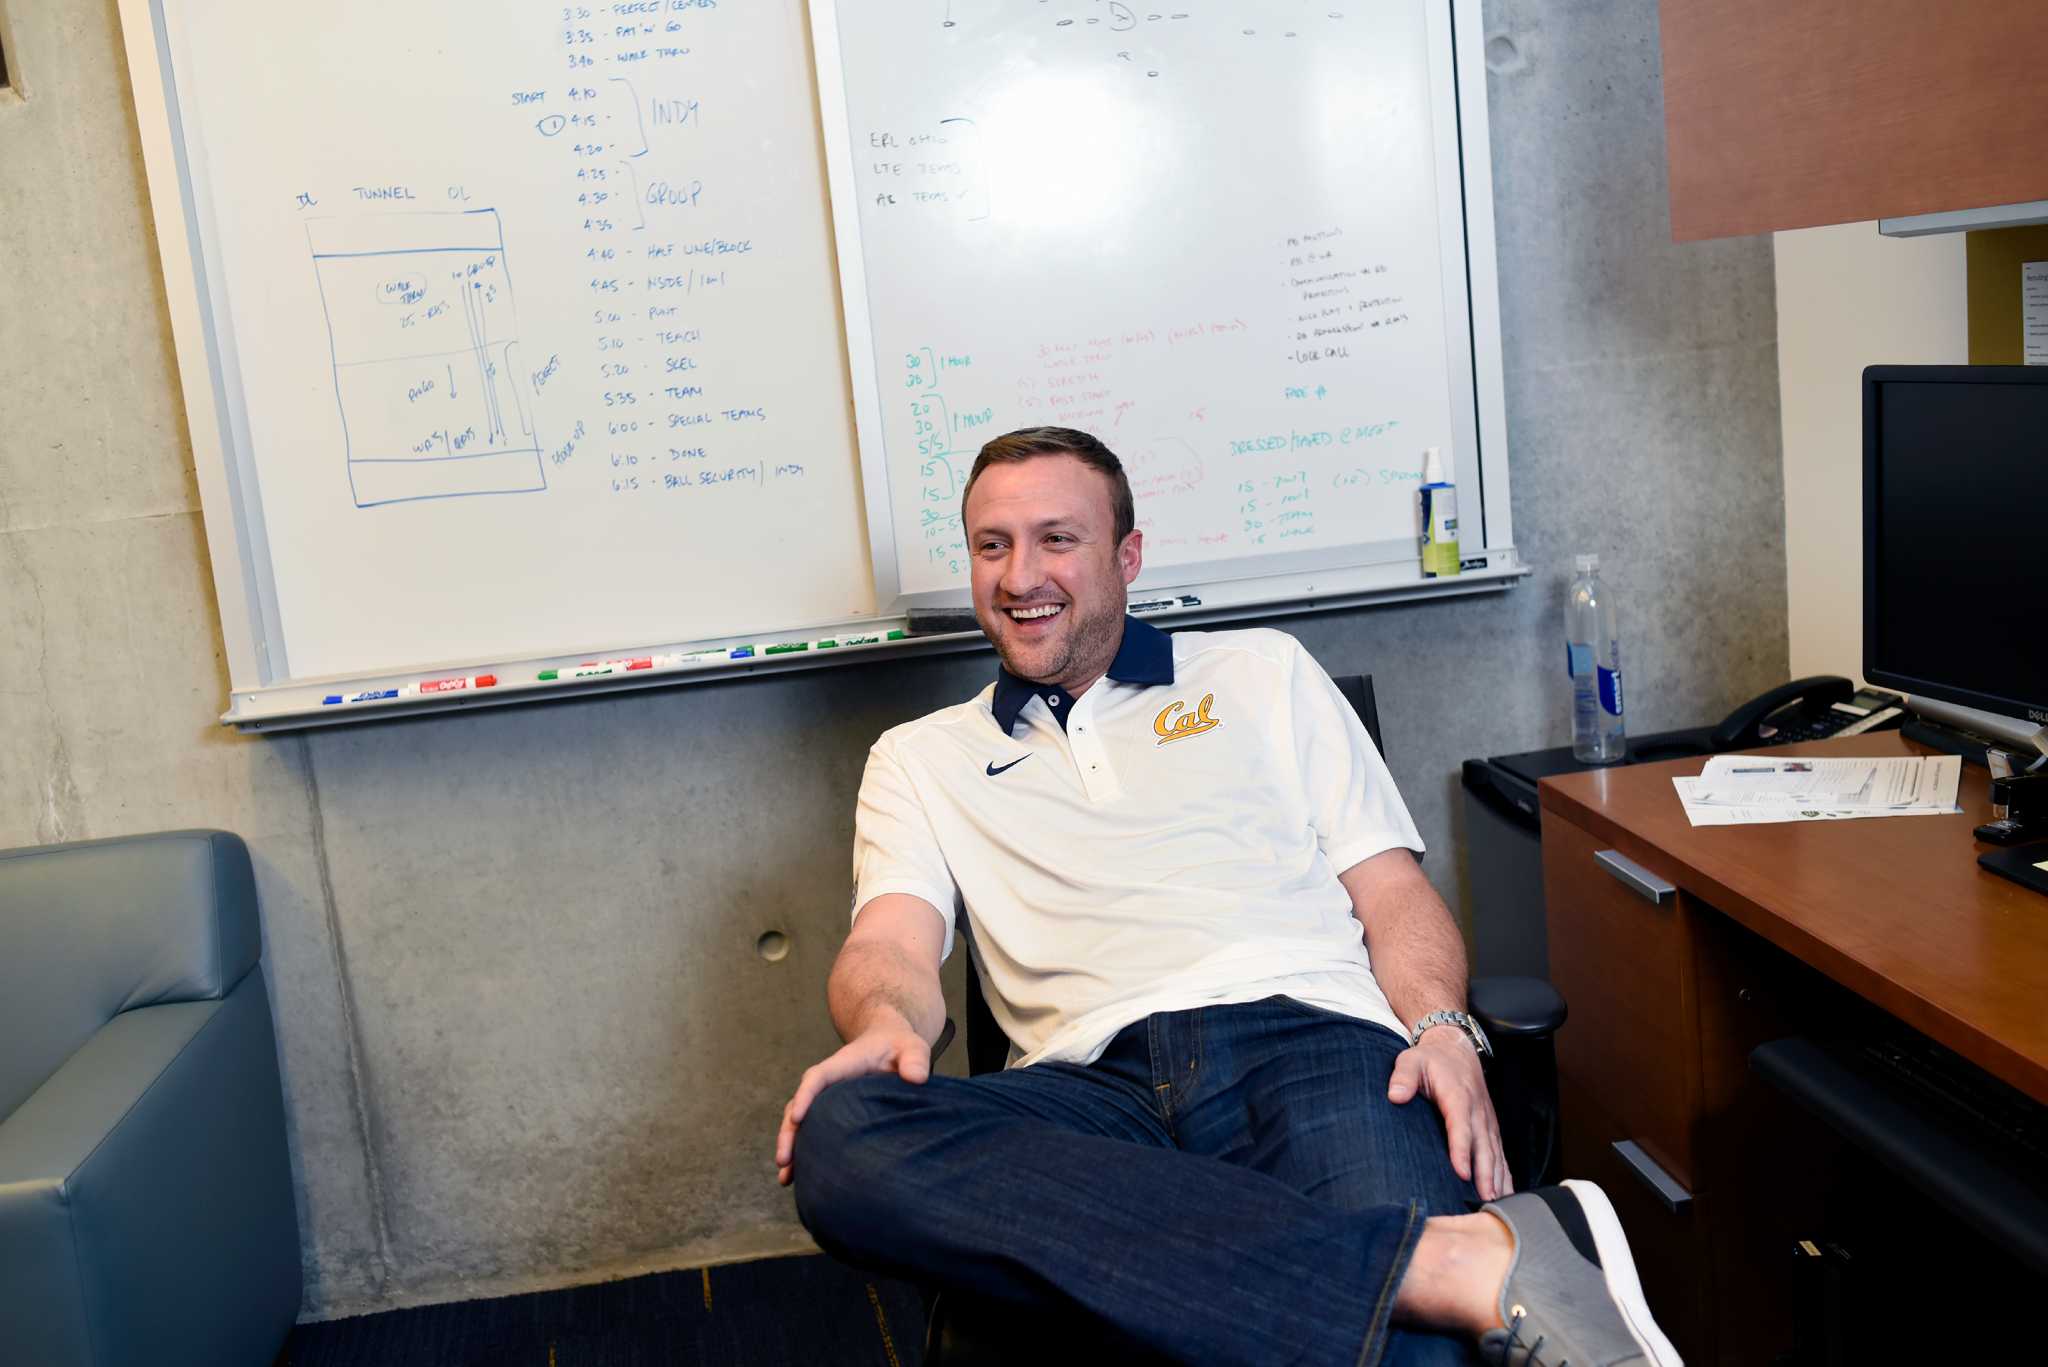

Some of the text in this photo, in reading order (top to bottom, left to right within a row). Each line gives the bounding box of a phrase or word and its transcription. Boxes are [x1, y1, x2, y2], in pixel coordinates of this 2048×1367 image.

[512, 91, 546, 105] START
[651, 97, 699, 126] INDY
[352, 187, 416, 200] TUNNEL
[646, 180, 702, 207] GROUP
[664, 386, 703, 400] TEAM
[667, 413, 713, 428] SPECIAL
[720, 406, 767, 423] TEAMS
[668, 447, 708, 461] DONE
[920, 461, 937, 476] 15
[664, 474, 693, 489] BALL
[922, 487, 942, 502] 15
[1152, 693, 1218, 745] Cal
